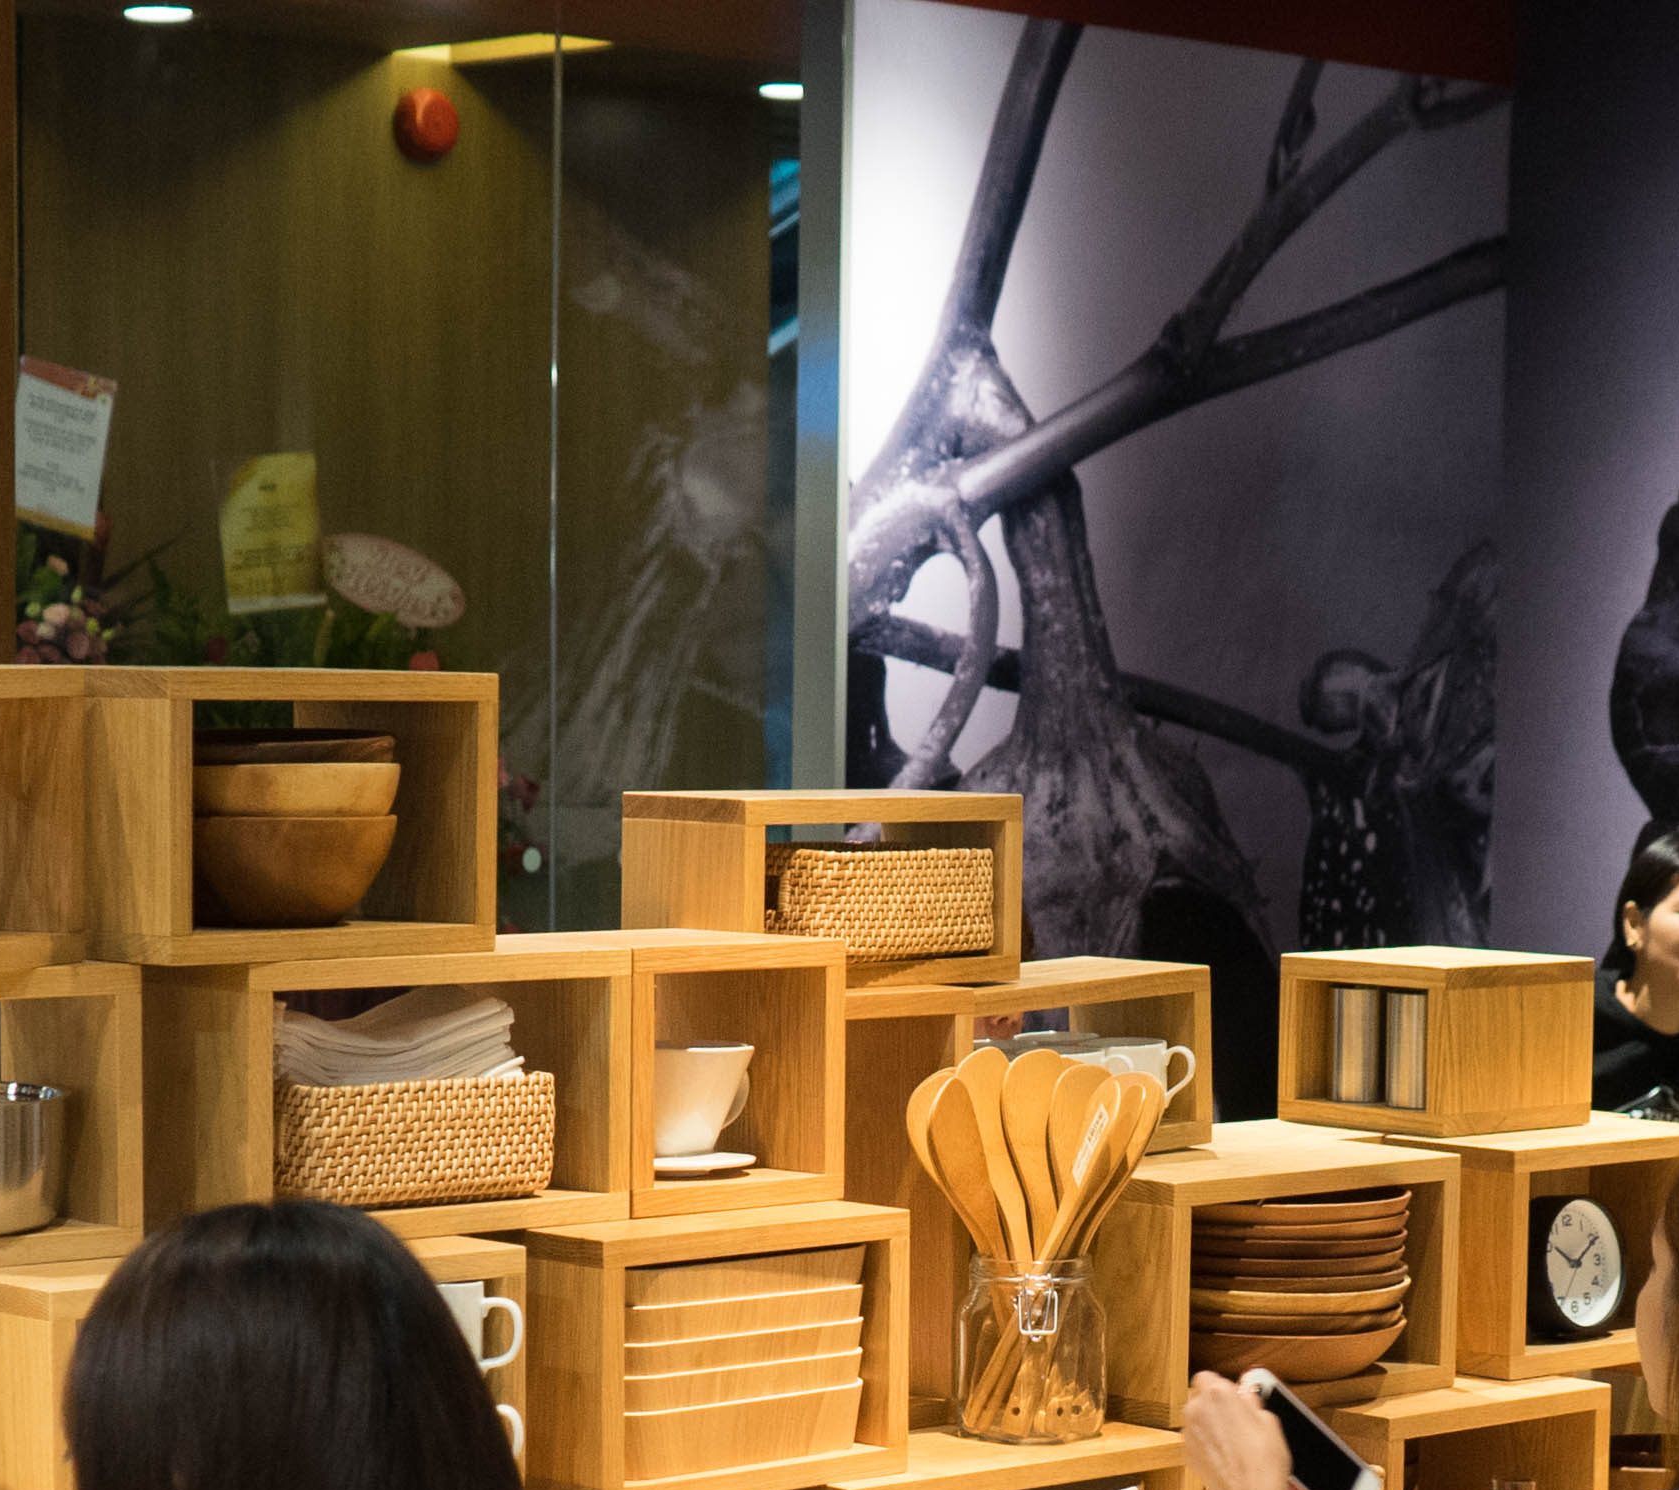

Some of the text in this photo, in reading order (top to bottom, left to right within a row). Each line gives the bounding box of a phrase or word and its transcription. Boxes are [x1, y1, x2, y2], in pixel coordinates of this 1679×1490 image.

[1561, 1213, 1572, 1227] 12
[1593, 1254, 1602, 1267] 3
[1591, 1275, 1600, 1287] 4
[1583, 1292, 1592, 1306] 5
[1571, 1301, 1579, 1314] 6
